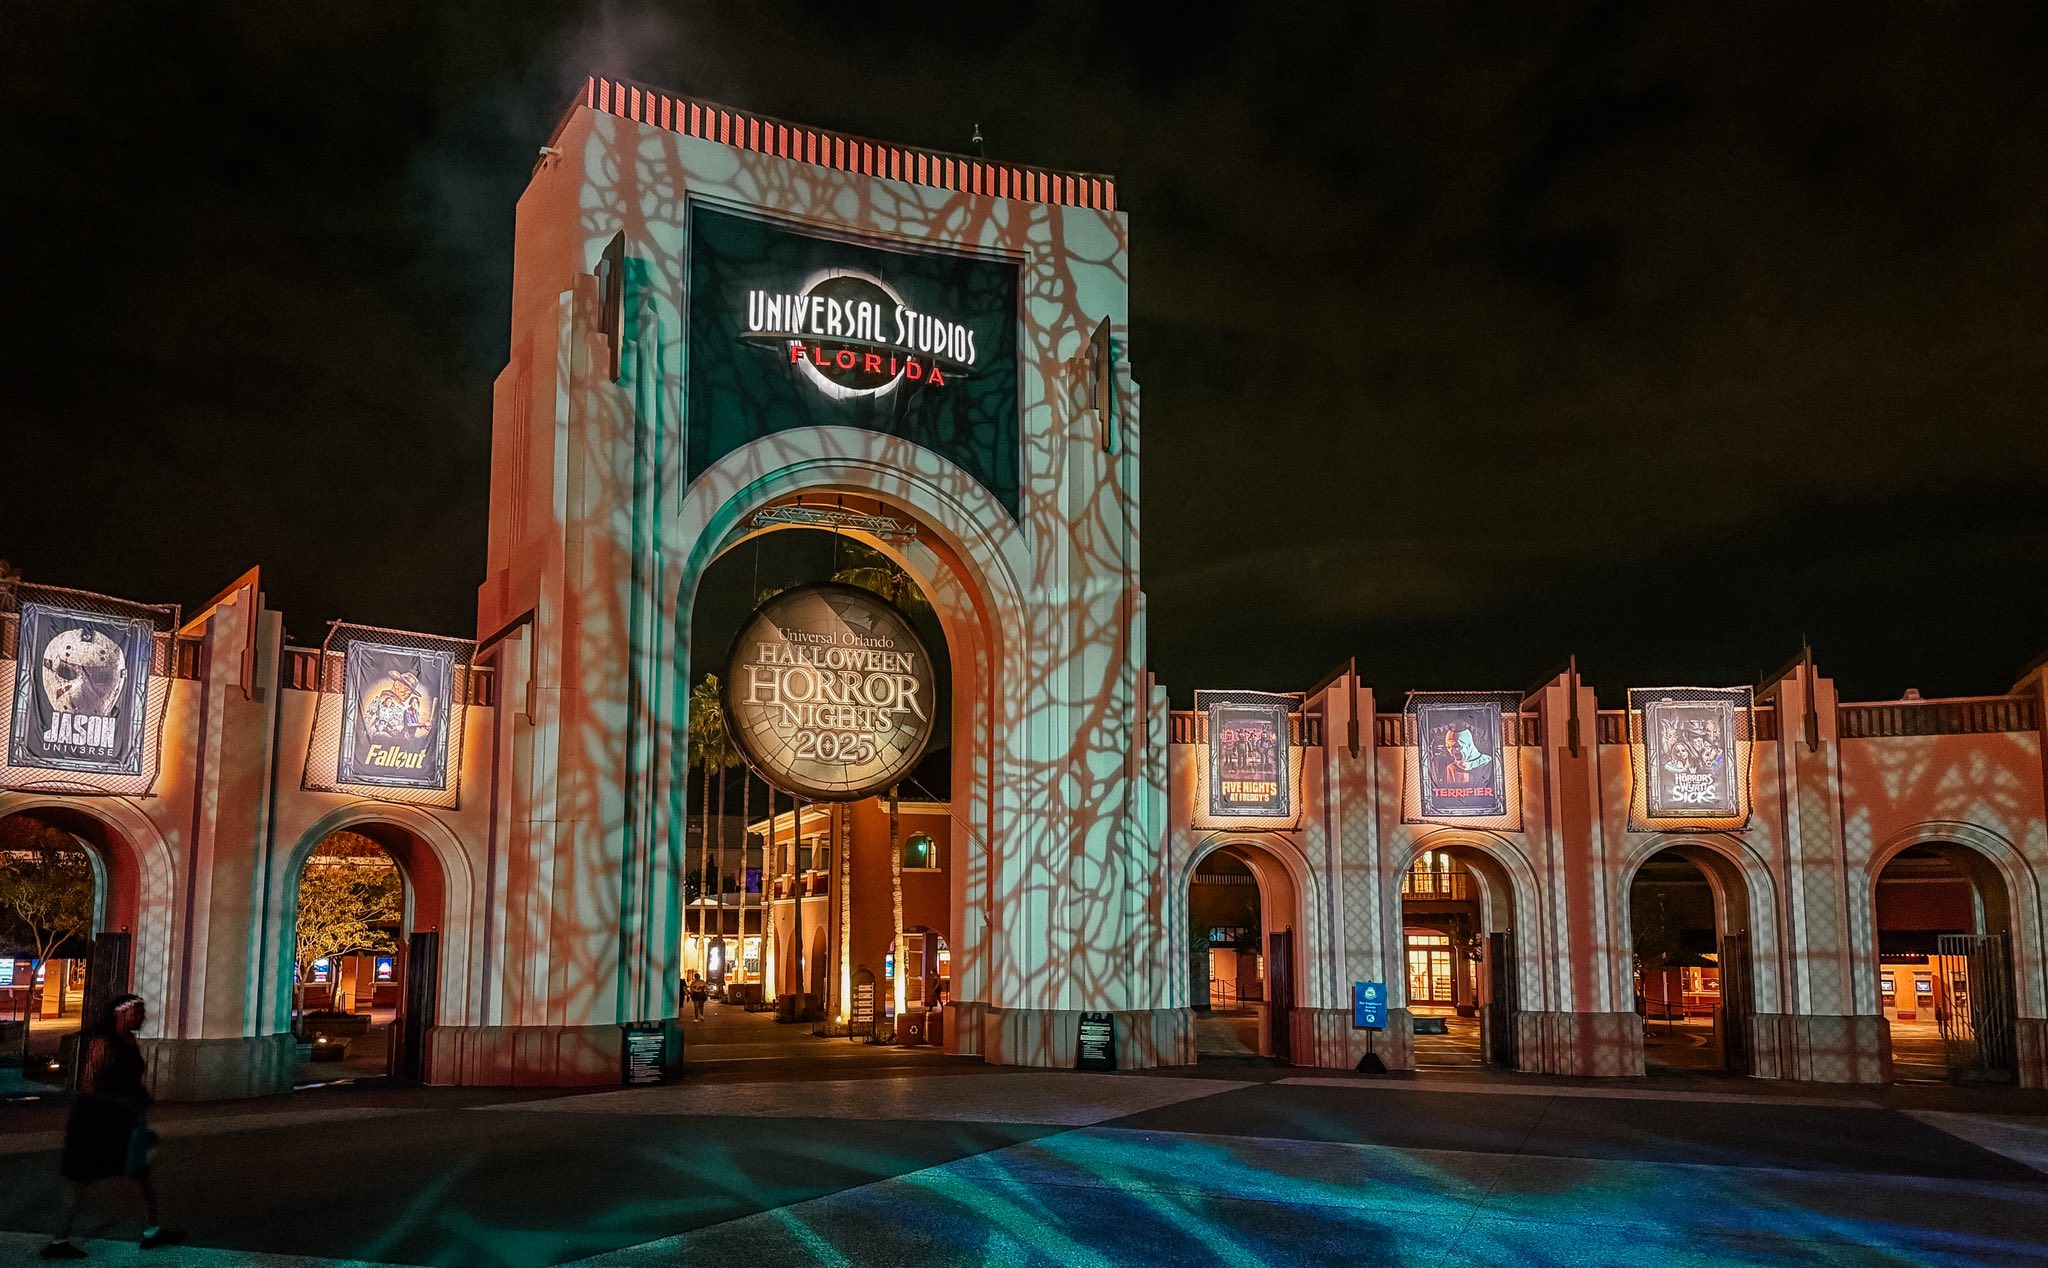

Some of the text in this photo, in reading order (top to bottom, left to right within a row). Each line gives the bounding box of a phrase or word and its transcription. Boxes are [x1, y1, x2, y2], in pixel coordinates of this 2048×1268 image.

[749, 290, 976, 365] UNIVERSAL STUDIOS
[790, 345, 945, 387] FLORIDA
[778, 627, 894, 649] Universal Orlando
[756, 642, 915, 674] HALLOWEEN
[743, 664, 928, 723] HORROR
[43, 711, 117, 749] JASON
[778, 702, 894, 732] NIGHTS
[42, 742, 115, 757] UN1V3RSE
[364, 743, 427, 770] Fallout
[795, 730, 877, 766] 2025
[1221, 781, 1278, 796] FIVE NIGHTS
[1432, 787, 1494, 799] TERRIFIER
[1674, 773, 1714, 785] HORRORS
[1229, 793, 1270, 802] AT FREDDY'S
